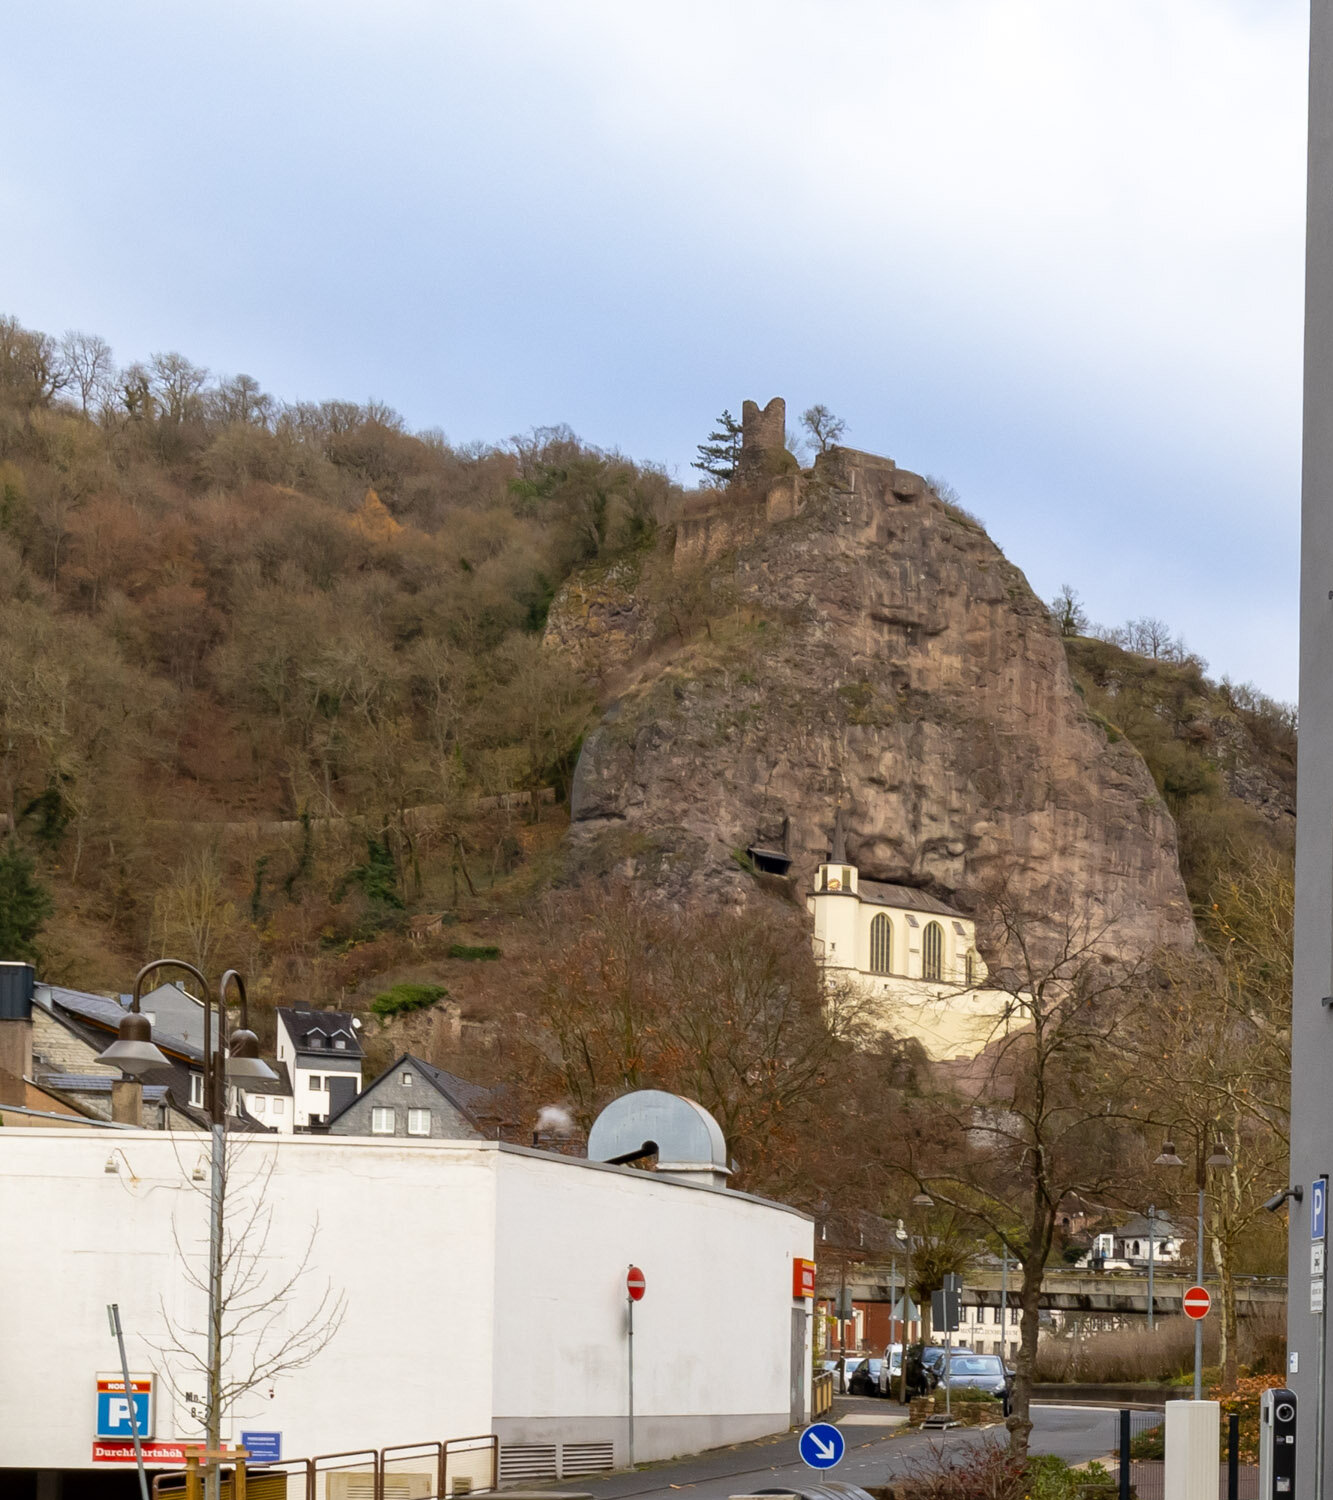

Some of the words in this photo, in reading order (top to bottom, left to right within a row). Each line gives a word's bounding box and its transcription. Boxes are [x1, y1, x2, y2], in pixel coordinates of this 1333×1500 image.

[1313, 1188, 1322, 1232] P
[107, 1382, 138, 1390] NORA
[108, 1398, 138, 1428] P
[95, 1447, 183, 1458] Durchfhrtshöh
